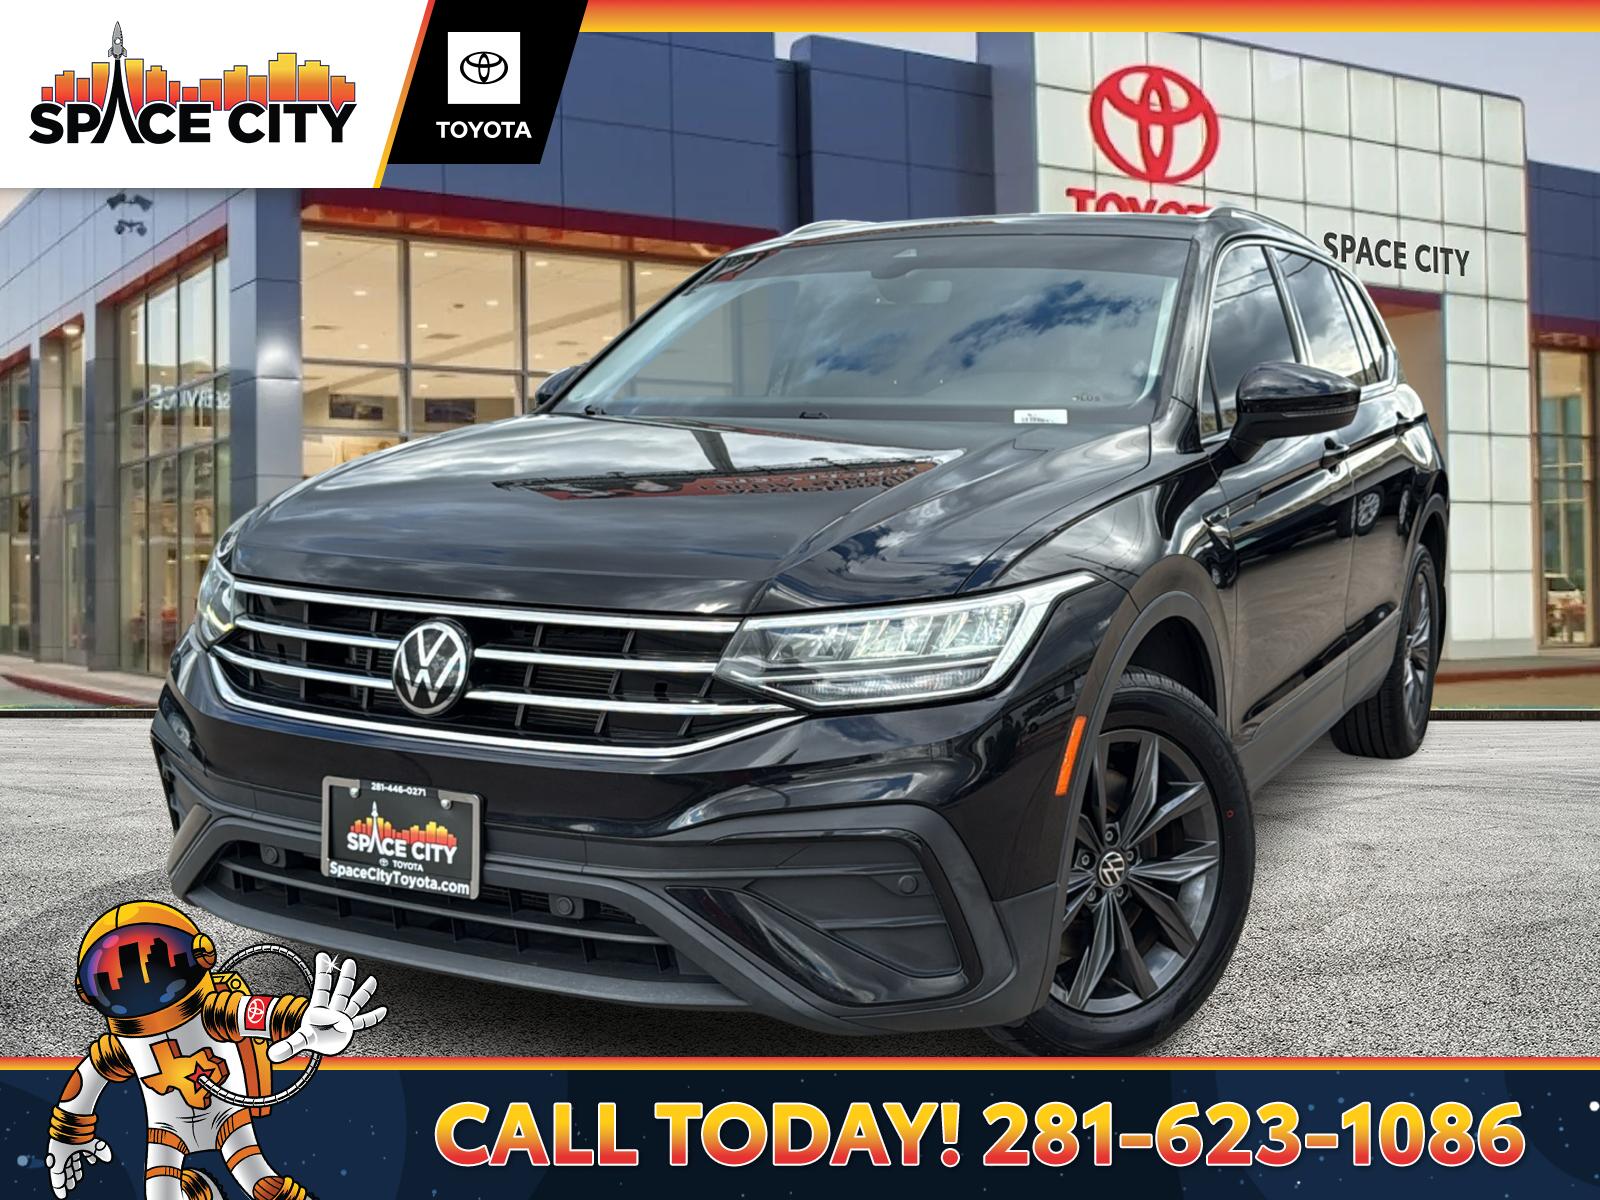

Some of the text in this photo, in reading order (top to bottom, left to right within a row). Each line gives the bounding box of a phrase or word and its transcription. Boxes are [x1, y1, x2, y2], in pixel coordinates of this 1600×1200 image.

[1066, 187, 1214, 214] TOY
[1323, 232, 1470, 276] SPACE CITY
[371, 782, 427, 797] 281-446-0271
[347, 831, 458, 865] SPACE CITY
[329, 860, 470, 896] SpaceCityToyota.com
[392, 859, 424, 872] TOYOTA
